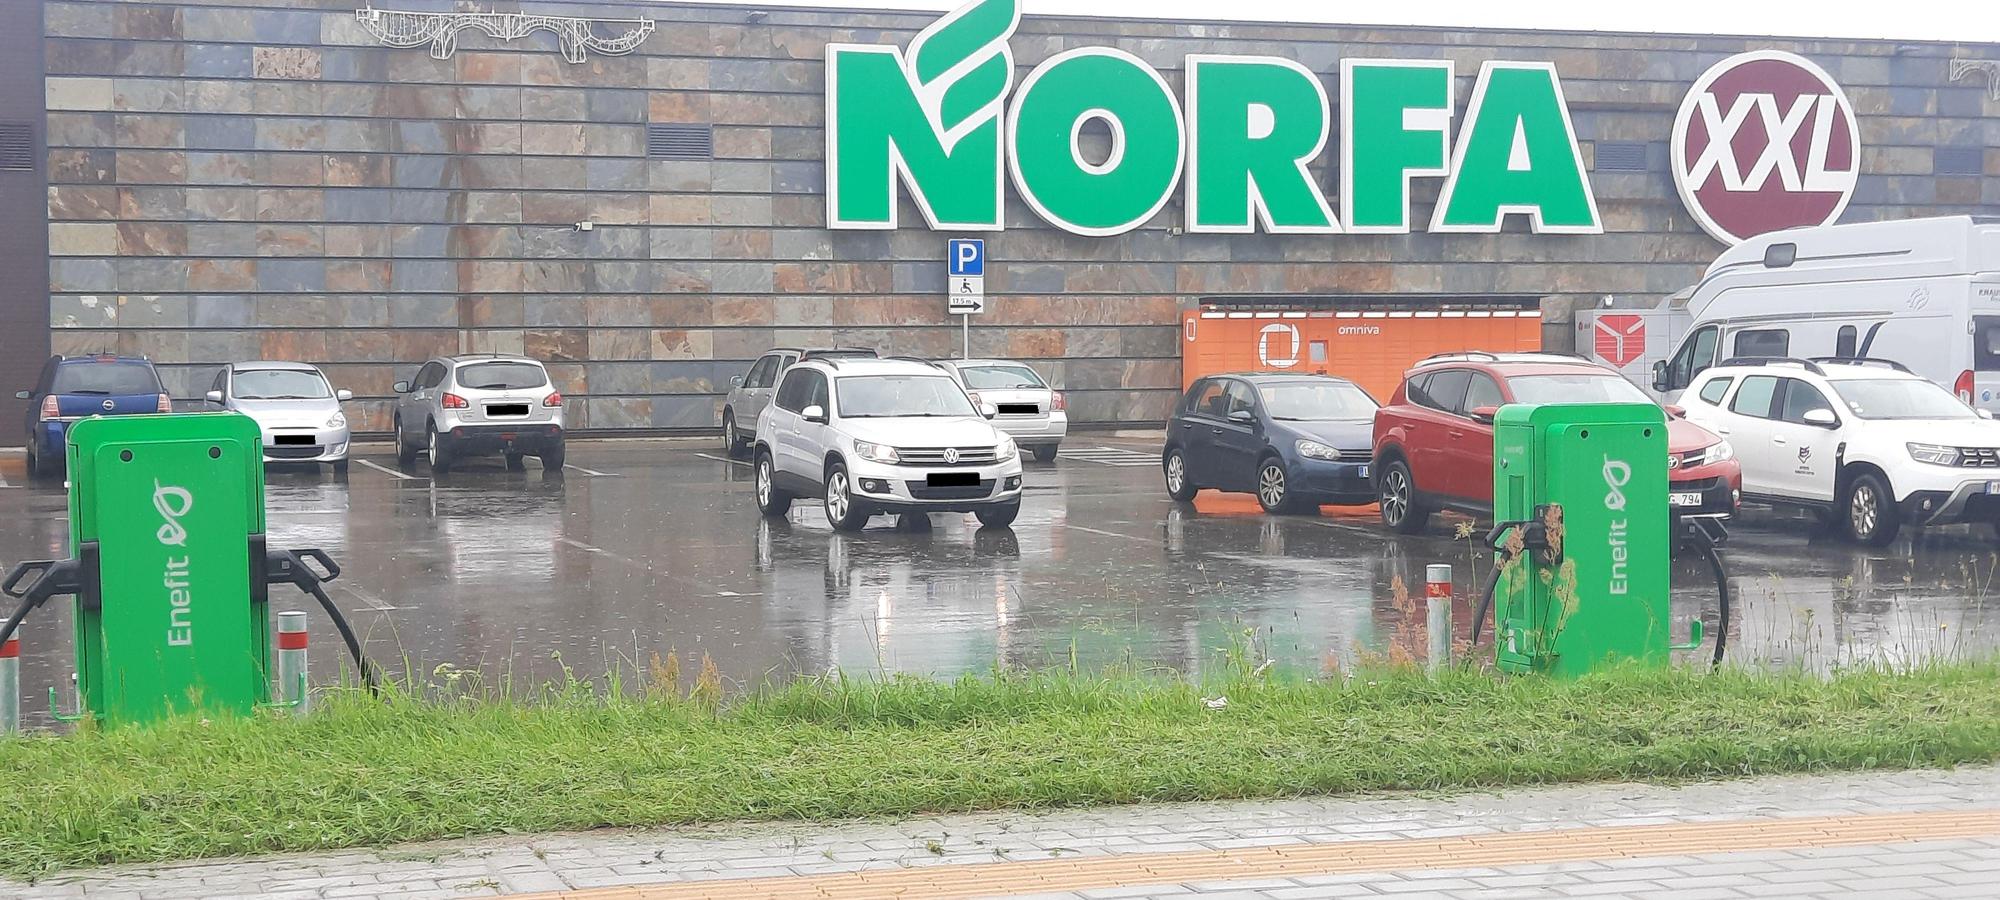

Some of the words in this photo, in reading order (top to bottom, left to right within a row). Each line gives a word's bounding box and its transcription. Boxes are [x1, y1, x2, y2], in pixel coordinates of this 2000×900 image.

[826, 42, 1603, 237] NORFA
[1687, 92, 1853, 192] XXL
[958, 243, 978, 273] P
[1338, 323, 1380, 335] omniva
[1682, 494, 1700, 505] 794
[1609, 518, 1628, 595] Enefit
[164, 555, 192, 646] Enefit
